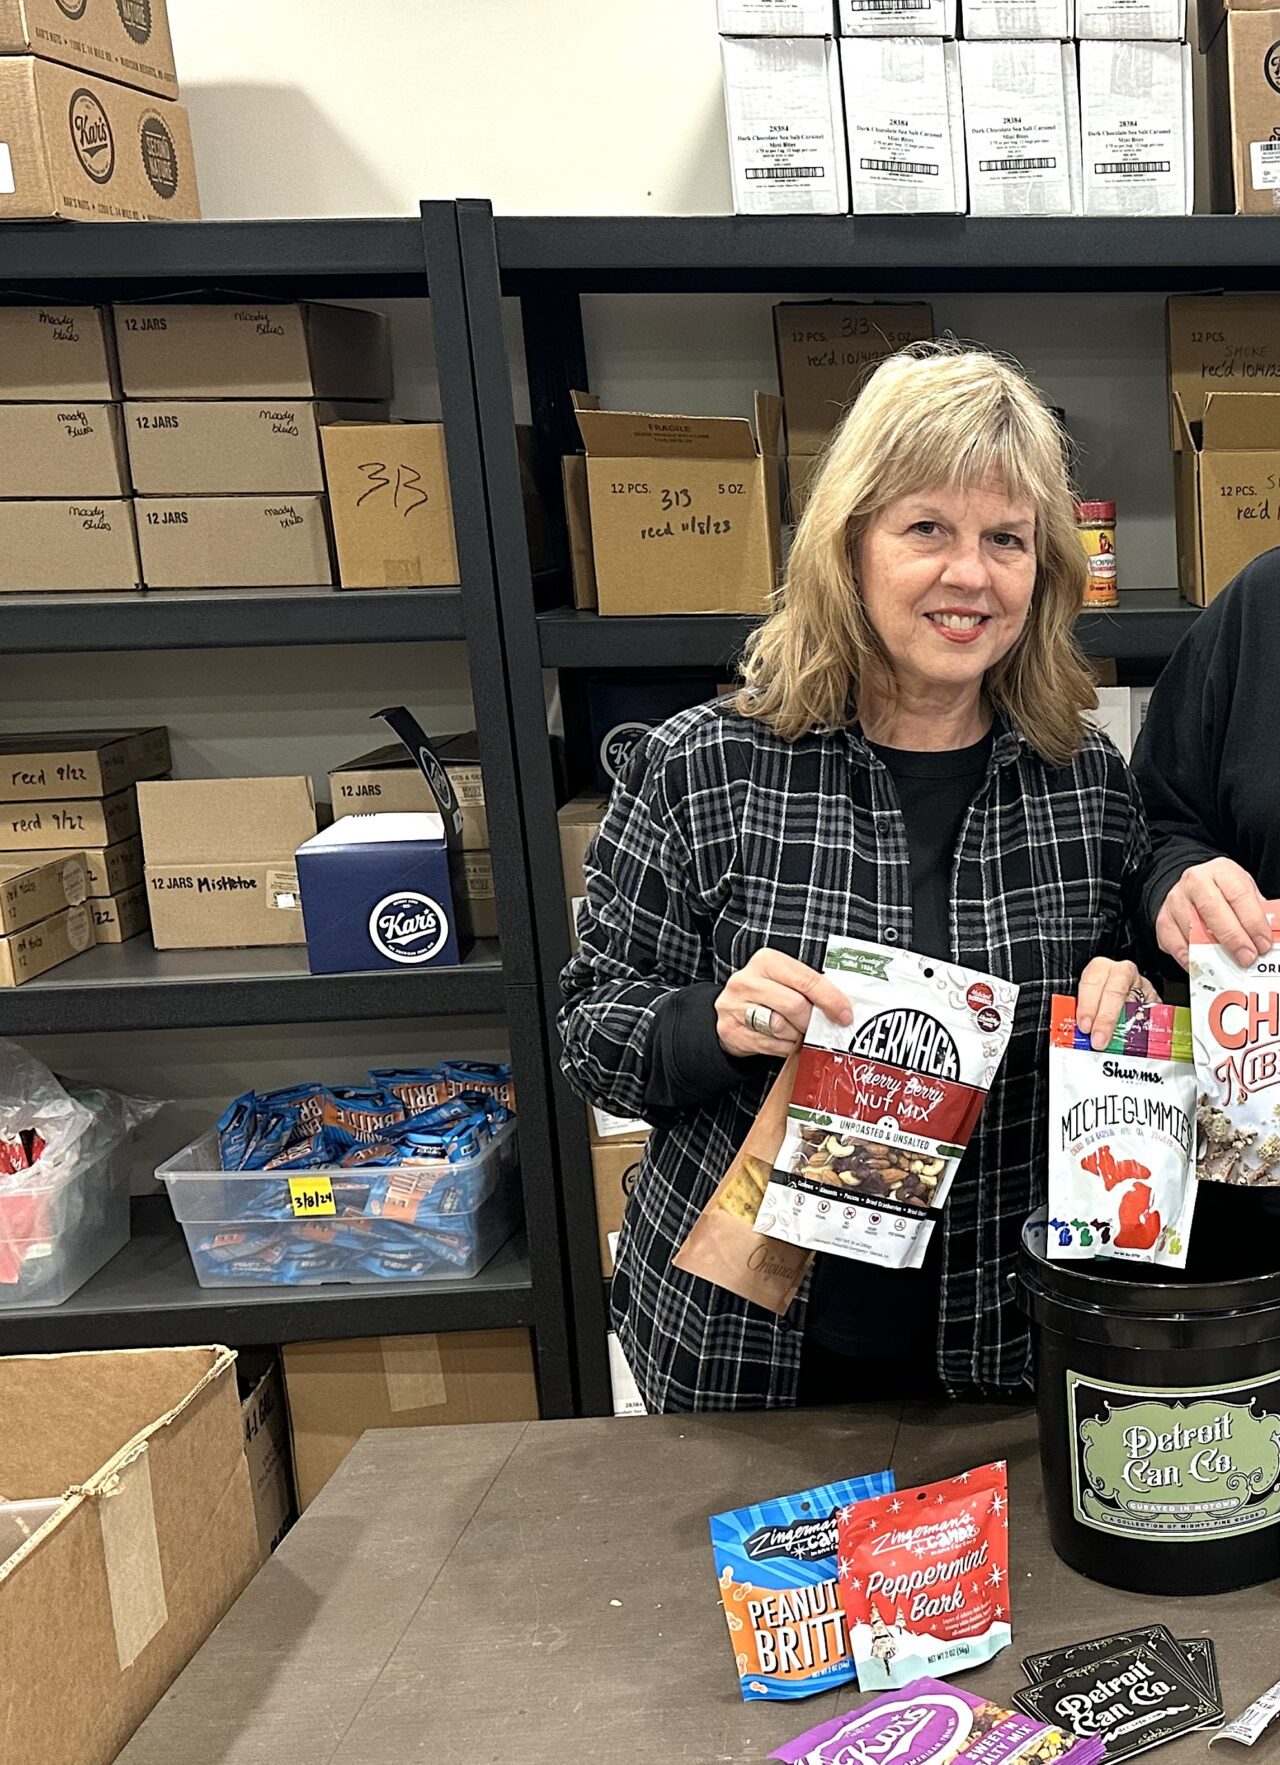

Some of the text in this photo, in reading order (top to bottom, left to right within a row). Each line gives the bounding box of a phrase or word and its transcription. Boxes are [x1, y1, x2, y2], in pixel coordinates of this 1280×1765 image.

[75, 114, 107, 146] Kar's
[125, 318, 168, 331] 12 JARS
[1191, 332, 1204, 342] 12
[1206, 331, 1227, 343] PCS.
[136, 416, 179, 429] 12 JARS
[610, 482, 747, 495] 12 PCS. 5 OZ.
[660, 488, 692, 511] 313
[1220, 486, 1233, 497] 12
[1235, 485, 1258, 497] PCS.
[146, 511, 188, 525] 12 JARS
[341, 784, 382, 797] 12 JARS
[152, 876, 194, 890] 12 JARS
[379, 908, 437, 940] Kar's
[852, 1010, 958, 1082] GERMACK
[852, 1063, 945, 1107] Cherry Berry
[855, 1091, 932, 1123] NUT MIX
[884, 1130, 892, 1141] &
[893, 1133, 930, 1151] UNSALTED
[294, 1191, 333, 1217] 3/8/24
[747, 1243, 801, 1281] Original
[1122, 1411, 1234, 1461] Detroit
[1121, 1448, 1238, 1494] Can Co.
[1117, 1519, 1164, 1529] COLLECTION
[1234, 1512, 1260, 1522] GOODS
[1130, 1499, 1237, 1512] CURATED IN MOTOWN
[872, 1509, 975, 1556] Zingerman's
[866, 1541, 989, 1602] Peppermint
[747, 1578, 838, 1630] PEANUT
[910, 1582, 966, 1621] Bark
[754, 1611, 848, 1673] BRITT
[1055, 1660, 1155, 1722] Detroit
[1072, 1702, 1135, 1738] Can
[1128, 1680, 1178, 1706] Co.
[834, 1706, 929, 1765] Kar's
[968, 1731, 1006, 1761] SWEET
[1007, 1723, 1035, 1745] MIX
